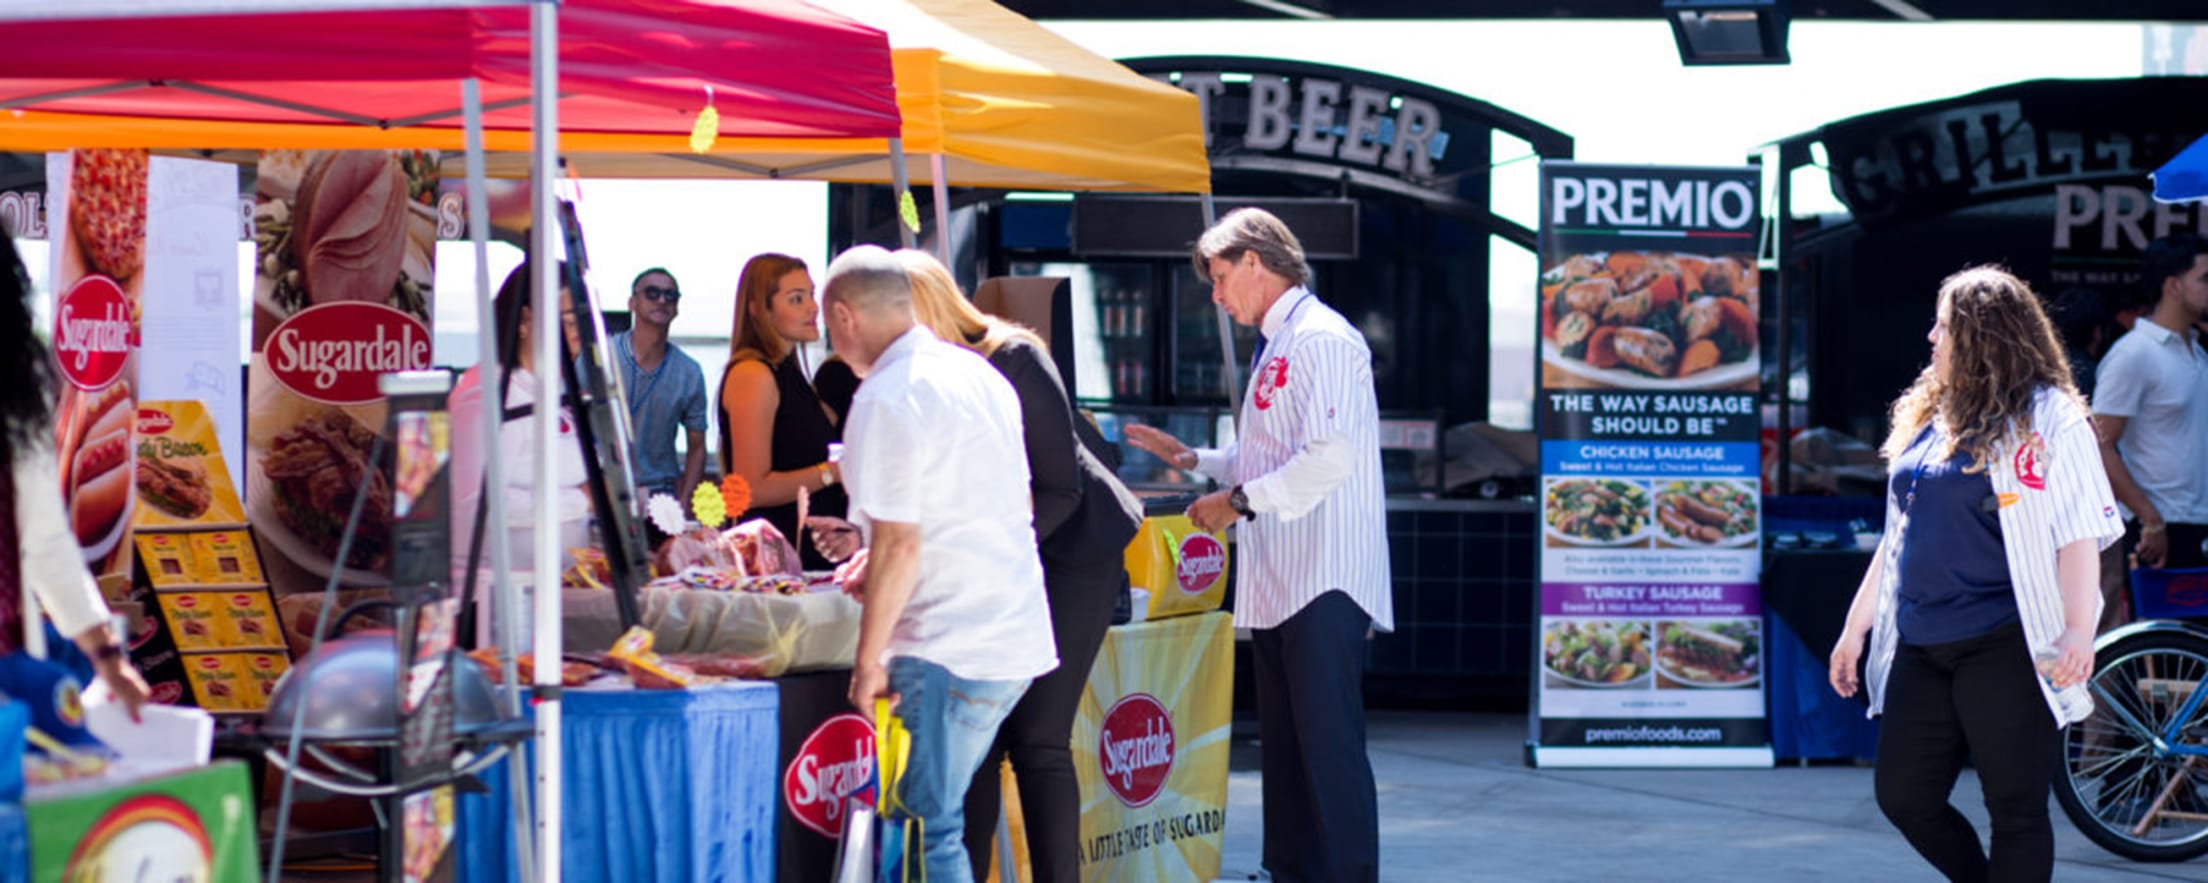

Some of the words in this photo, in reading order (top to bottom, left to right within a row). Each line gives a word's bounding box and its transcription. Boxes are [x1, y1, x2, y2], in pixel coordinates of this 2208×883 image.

[1244, 72, 1440, 176] BEER
[1552, 177, 1753, 229] PREMIO
[59, 302, 129, 371] Sugardale
[277, 324, 428, 389] Sugardale
[1550, 394, 1594, 411] THE
[1600, 396, 1648, 412] WAY
[1654, 396, 1753, 414] SAUSAGE
[1591, 416, 1680, 433] SHOULD
[1580, 446, 1649, 459] CHICKEN
[1653, 447, 1724, 460] SAUSAGE
[1559, 461, 1592, 471] Sweet
[1605, 461, 1623, 471] Hot
[1627, 461, 1656, 471] Italian
[1660, 463, 1699, 472] Chicken
[1702, 463, 1744, 473] Sausage
[1583, 586, 1645, 599] TURKEY
[1650, 587, 1723, 600] SAUSAGE
[1664, 604, 1697, 614] Turkey
[1585, 725, 1723, 744] premiofoods.com
[1103, 715, 1171, 790] Sugardale
